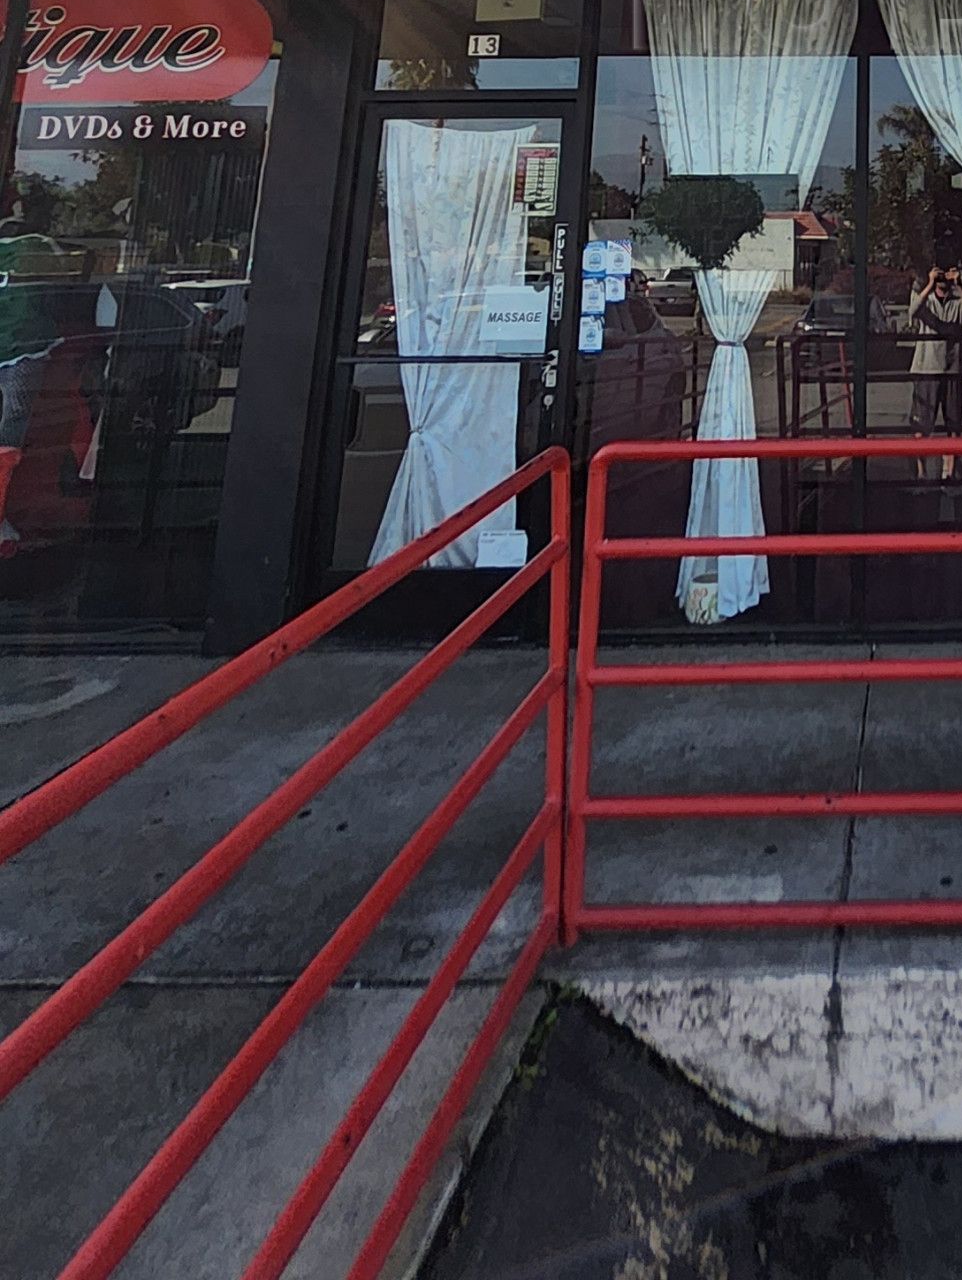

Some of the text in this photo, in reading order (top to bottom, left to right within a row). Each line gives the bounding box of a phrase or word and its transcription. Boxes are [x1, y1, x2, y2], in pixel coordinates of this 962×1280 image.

[18, 6, 226, 90] ique
[472, 36, 497, 54] 13
[37, 115, 247, 140] DVDs & More
[555, 228, 566, 270] PULL
[487, 311, 542, 323] MASSAGE
